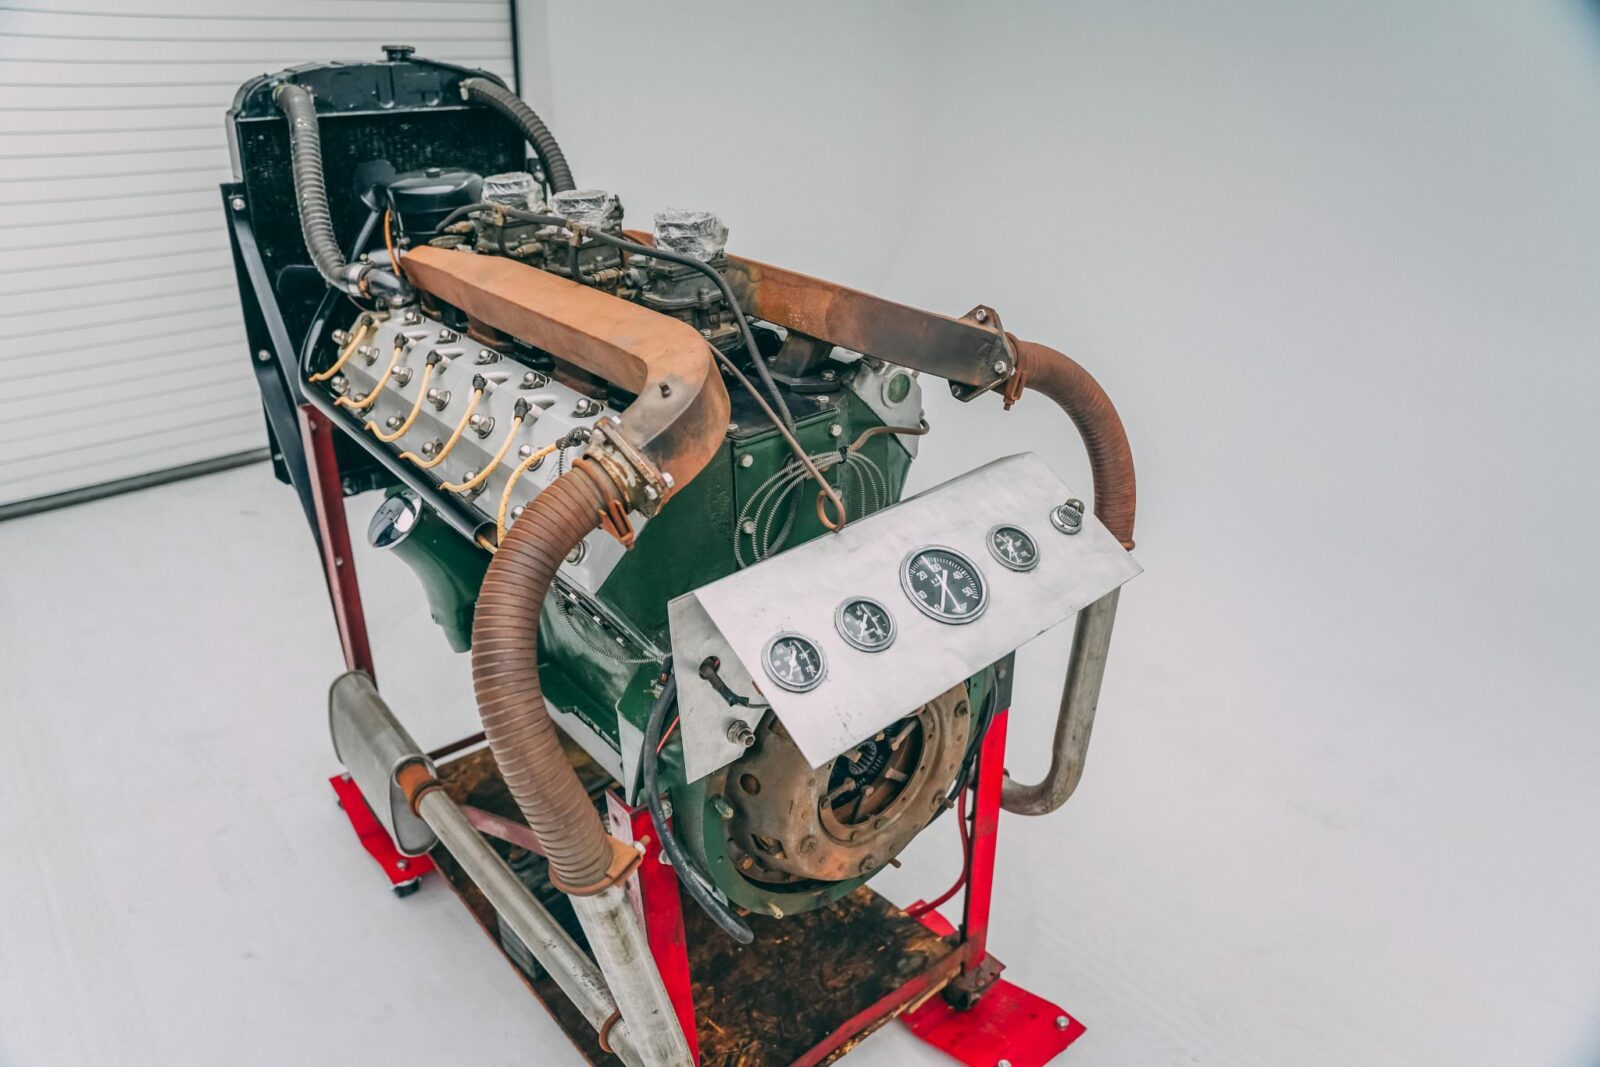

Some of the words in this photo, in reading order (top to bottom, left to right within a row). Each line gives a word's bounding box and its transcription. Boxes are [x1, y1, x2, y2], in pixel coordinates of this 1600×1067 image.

[916, 570, 928, 581] 20
[952, 570, 963, 580] 40
[962, 586, 974, 597] 50
